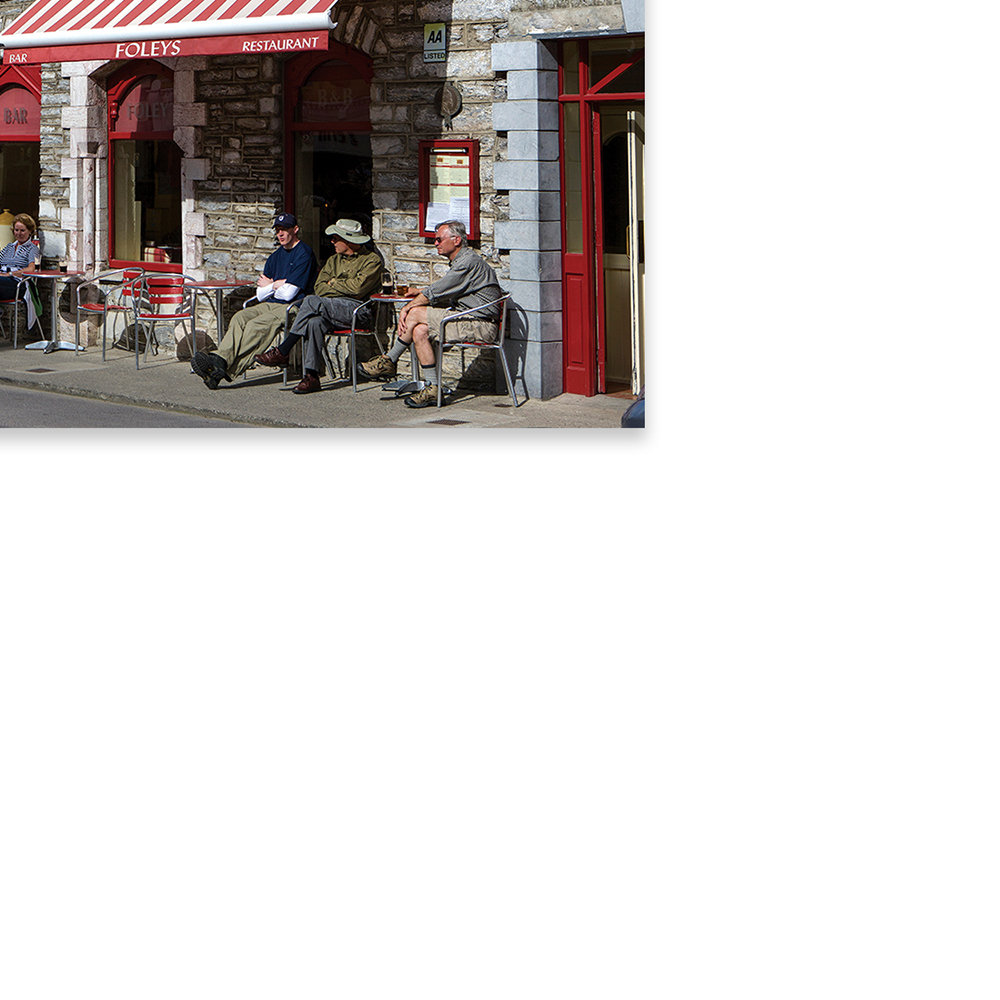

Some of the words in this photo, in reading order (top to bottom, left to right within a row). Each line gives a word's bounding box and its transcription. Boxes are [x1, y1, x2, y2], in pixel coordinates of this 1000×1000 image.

[242, 36, 319, 52] RESTAURANT
[427, 30, 442, 44] AA
[115, 39, 181, 59] FOLEYS
[424, 52, 446, 60] LISTED
[9, 53, 28, 64] BAR
[3, 106, 28, 125] BAR
